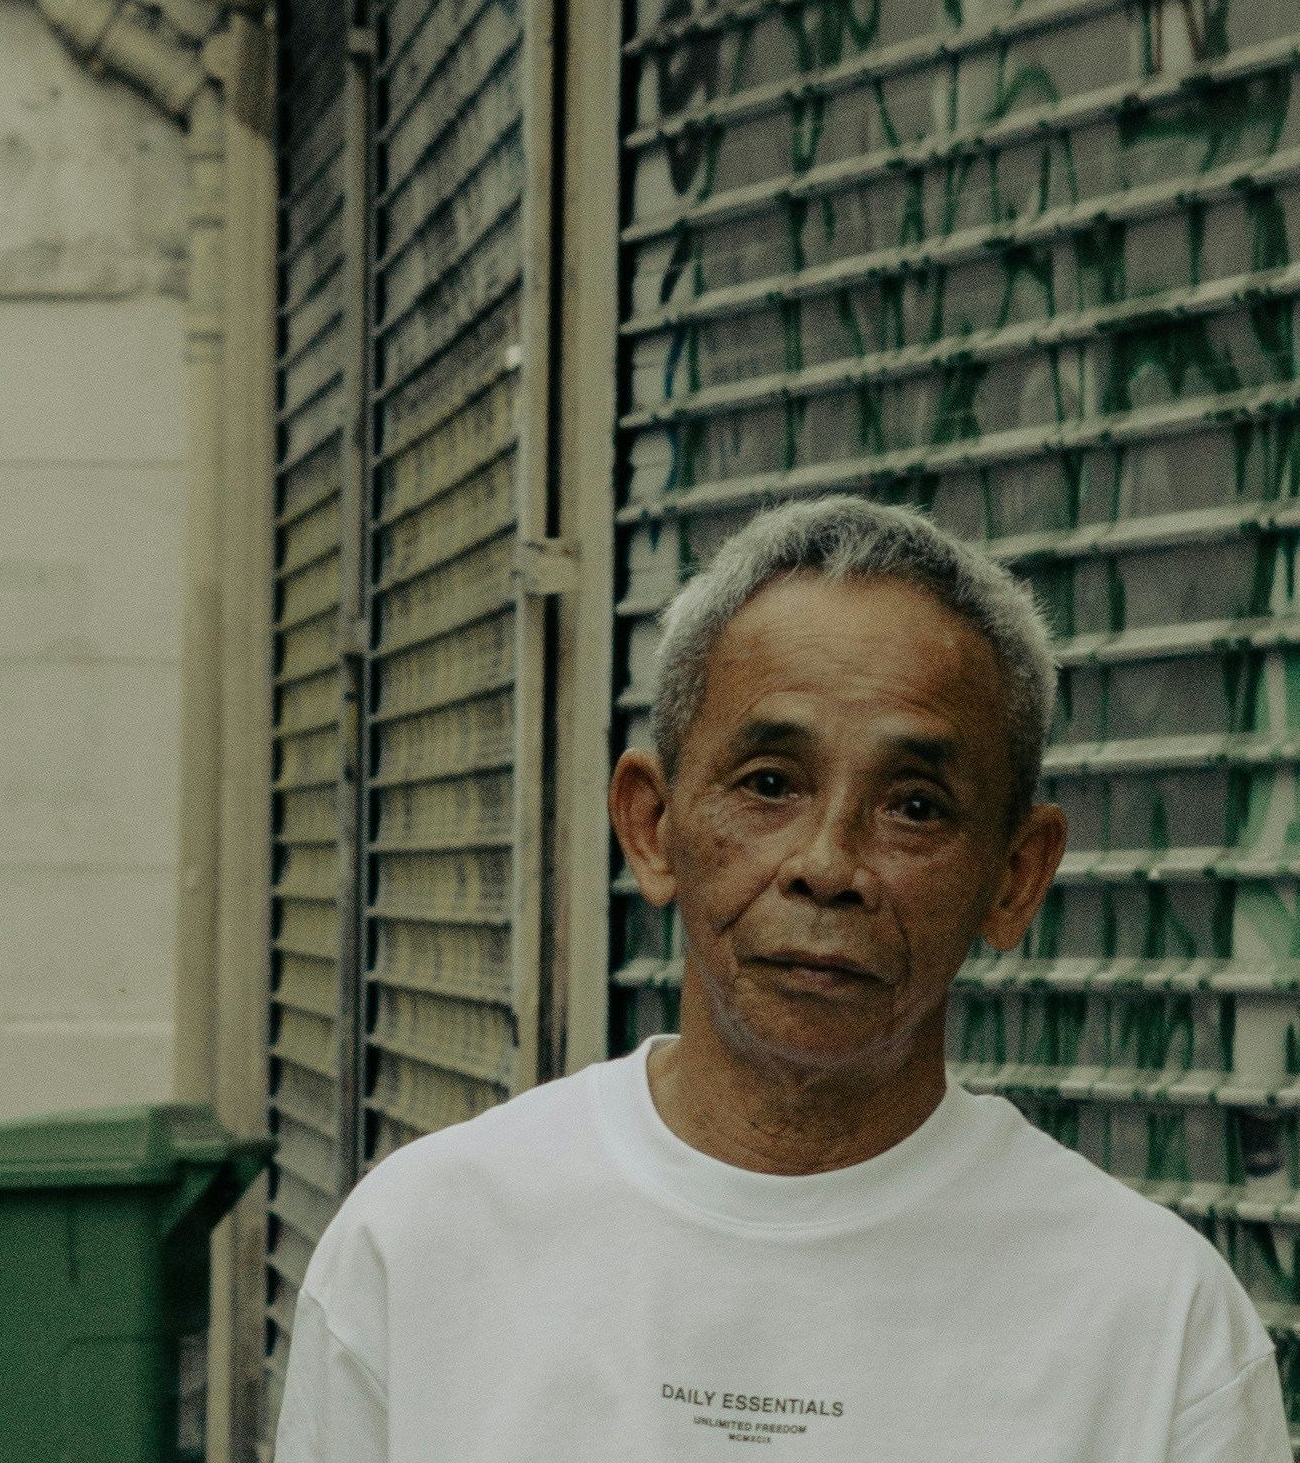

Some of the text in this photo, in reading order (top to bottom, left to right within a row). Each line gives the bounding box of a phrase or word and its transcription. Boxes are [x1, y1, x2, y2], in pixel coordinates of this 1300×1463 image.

[661, 1383, 845, 1417] DAILY ESSENTIALS
[693, 1416, 808, 1435] UNLIMITED FREEDOM
